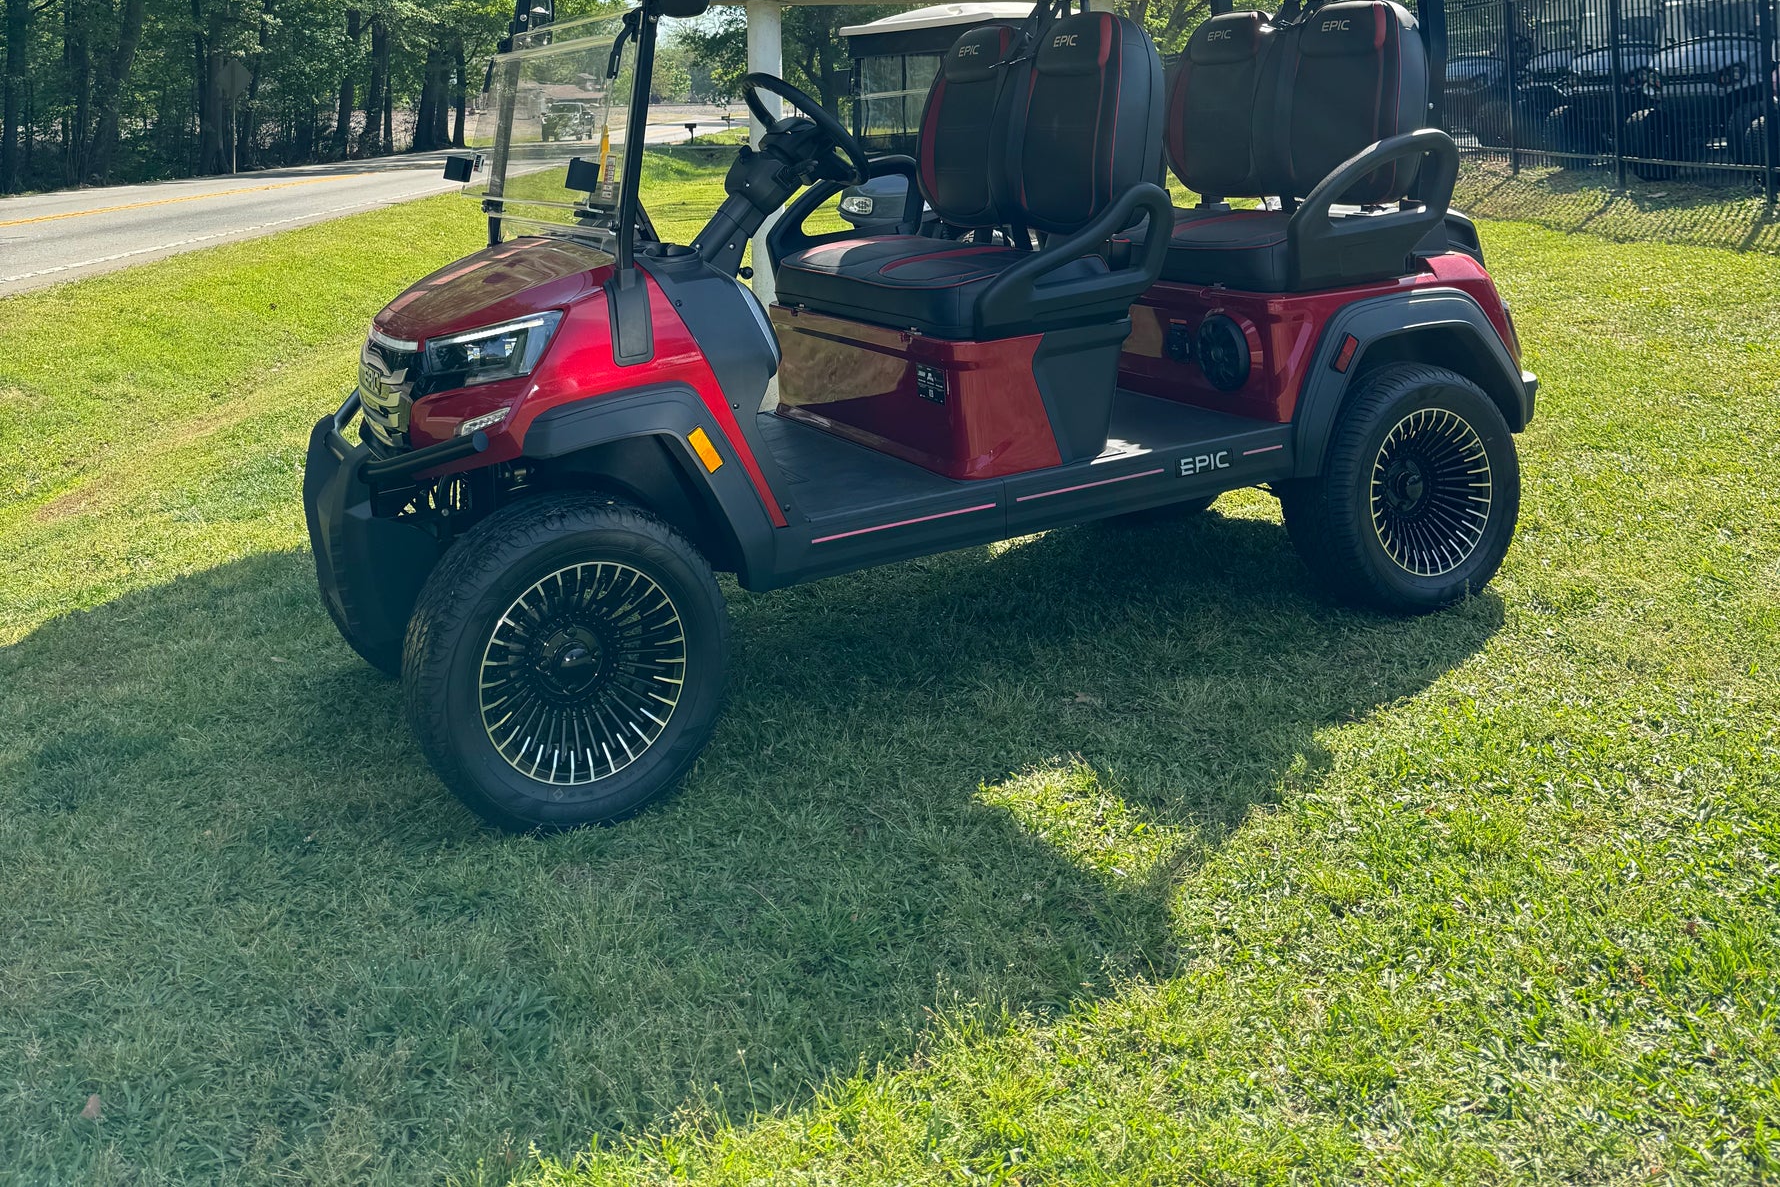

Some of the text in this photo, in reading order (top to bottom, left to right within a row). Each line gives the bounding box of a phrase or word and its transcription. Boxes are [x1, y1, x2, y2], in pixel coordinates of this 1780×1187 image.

[1321, 19, 1351, 32] EPIC
[1053, 34, 1079, 48] EPIC
[1207, 29, 1232, 42] EPIC
[958, 44, 981, 57] EPIC
[1180, 450, 1231, 477] EPIC
